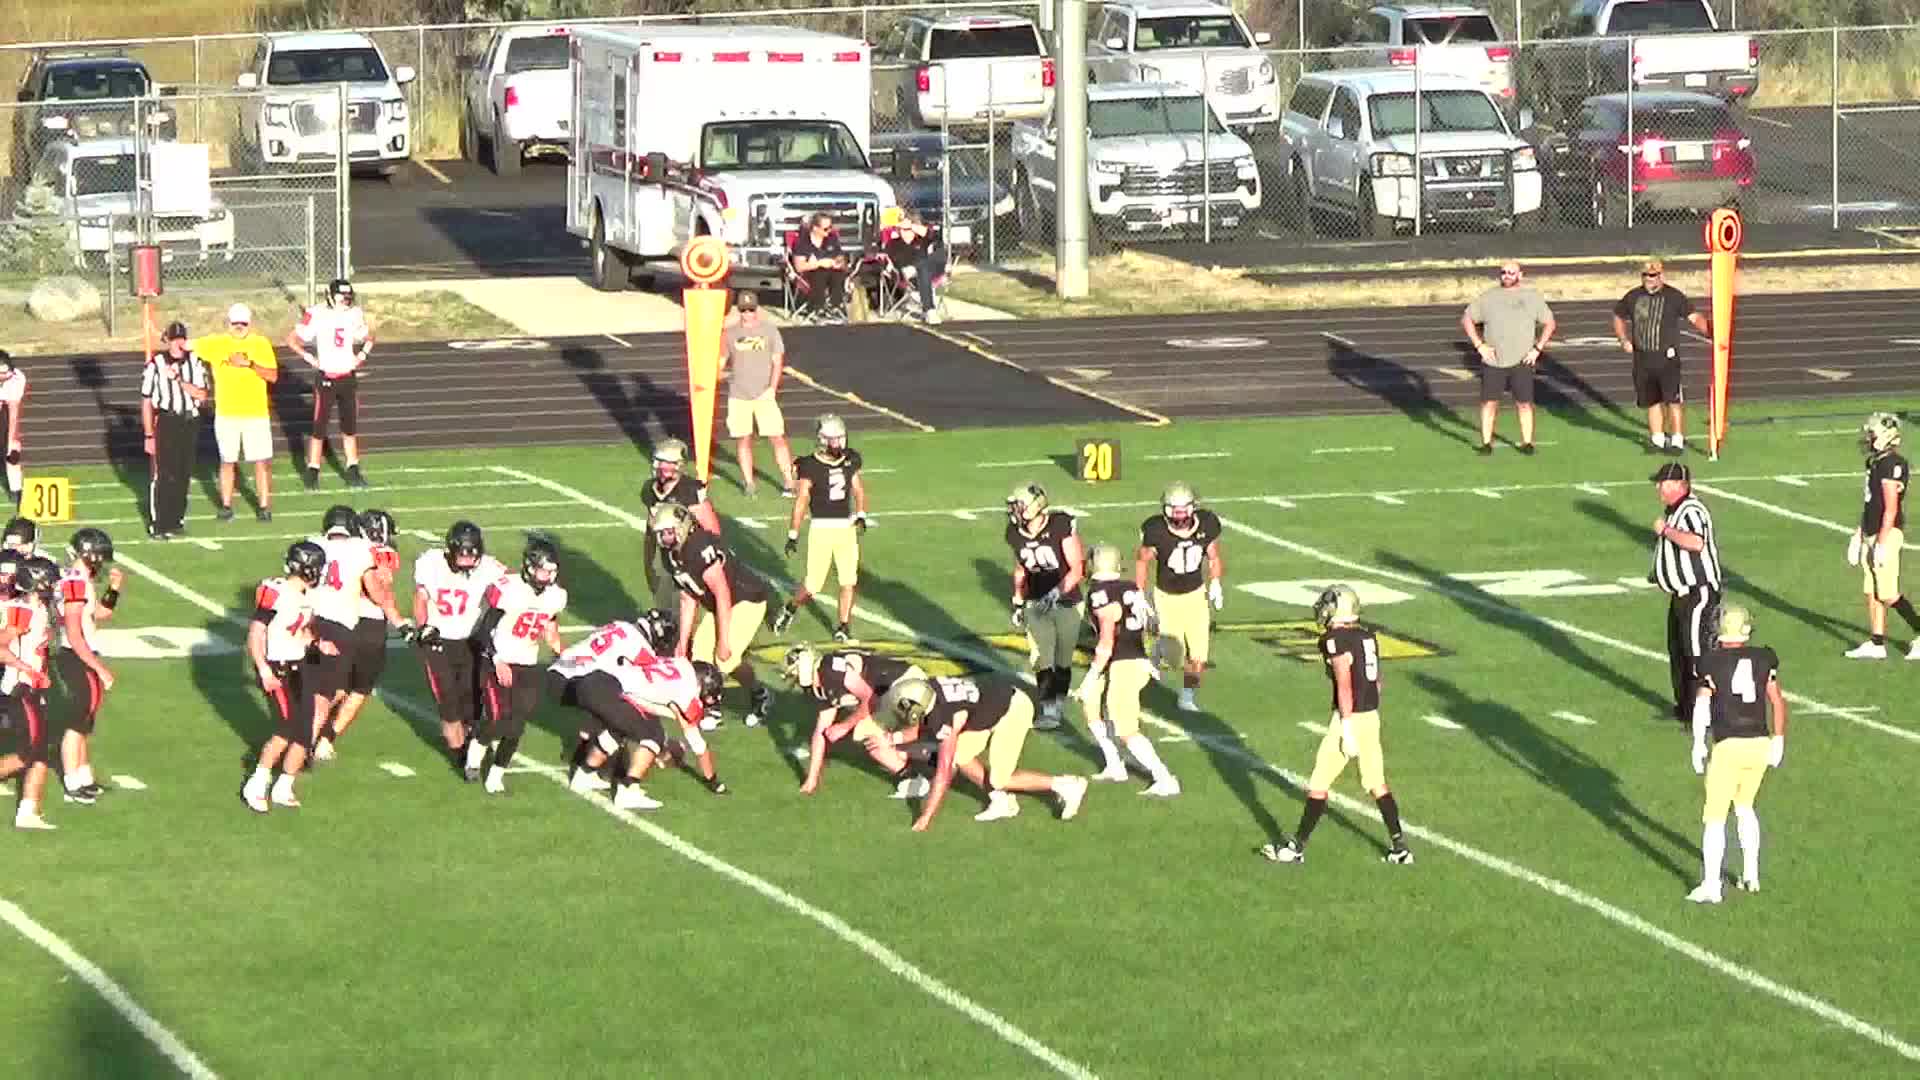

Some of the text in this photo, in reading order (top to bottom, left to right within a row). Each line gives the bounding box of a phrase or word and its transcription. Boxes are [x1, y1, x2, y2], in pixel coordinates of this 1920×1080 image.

[1083, 443, 1112, 480] 20
[33, 483, 59, 518] 30
[1167, 545, 1203, 574] 40
[436, 588, 469, 617] 57
[512, 611, 546, 641] 65
[1731, 658, 1757, 703] 4
